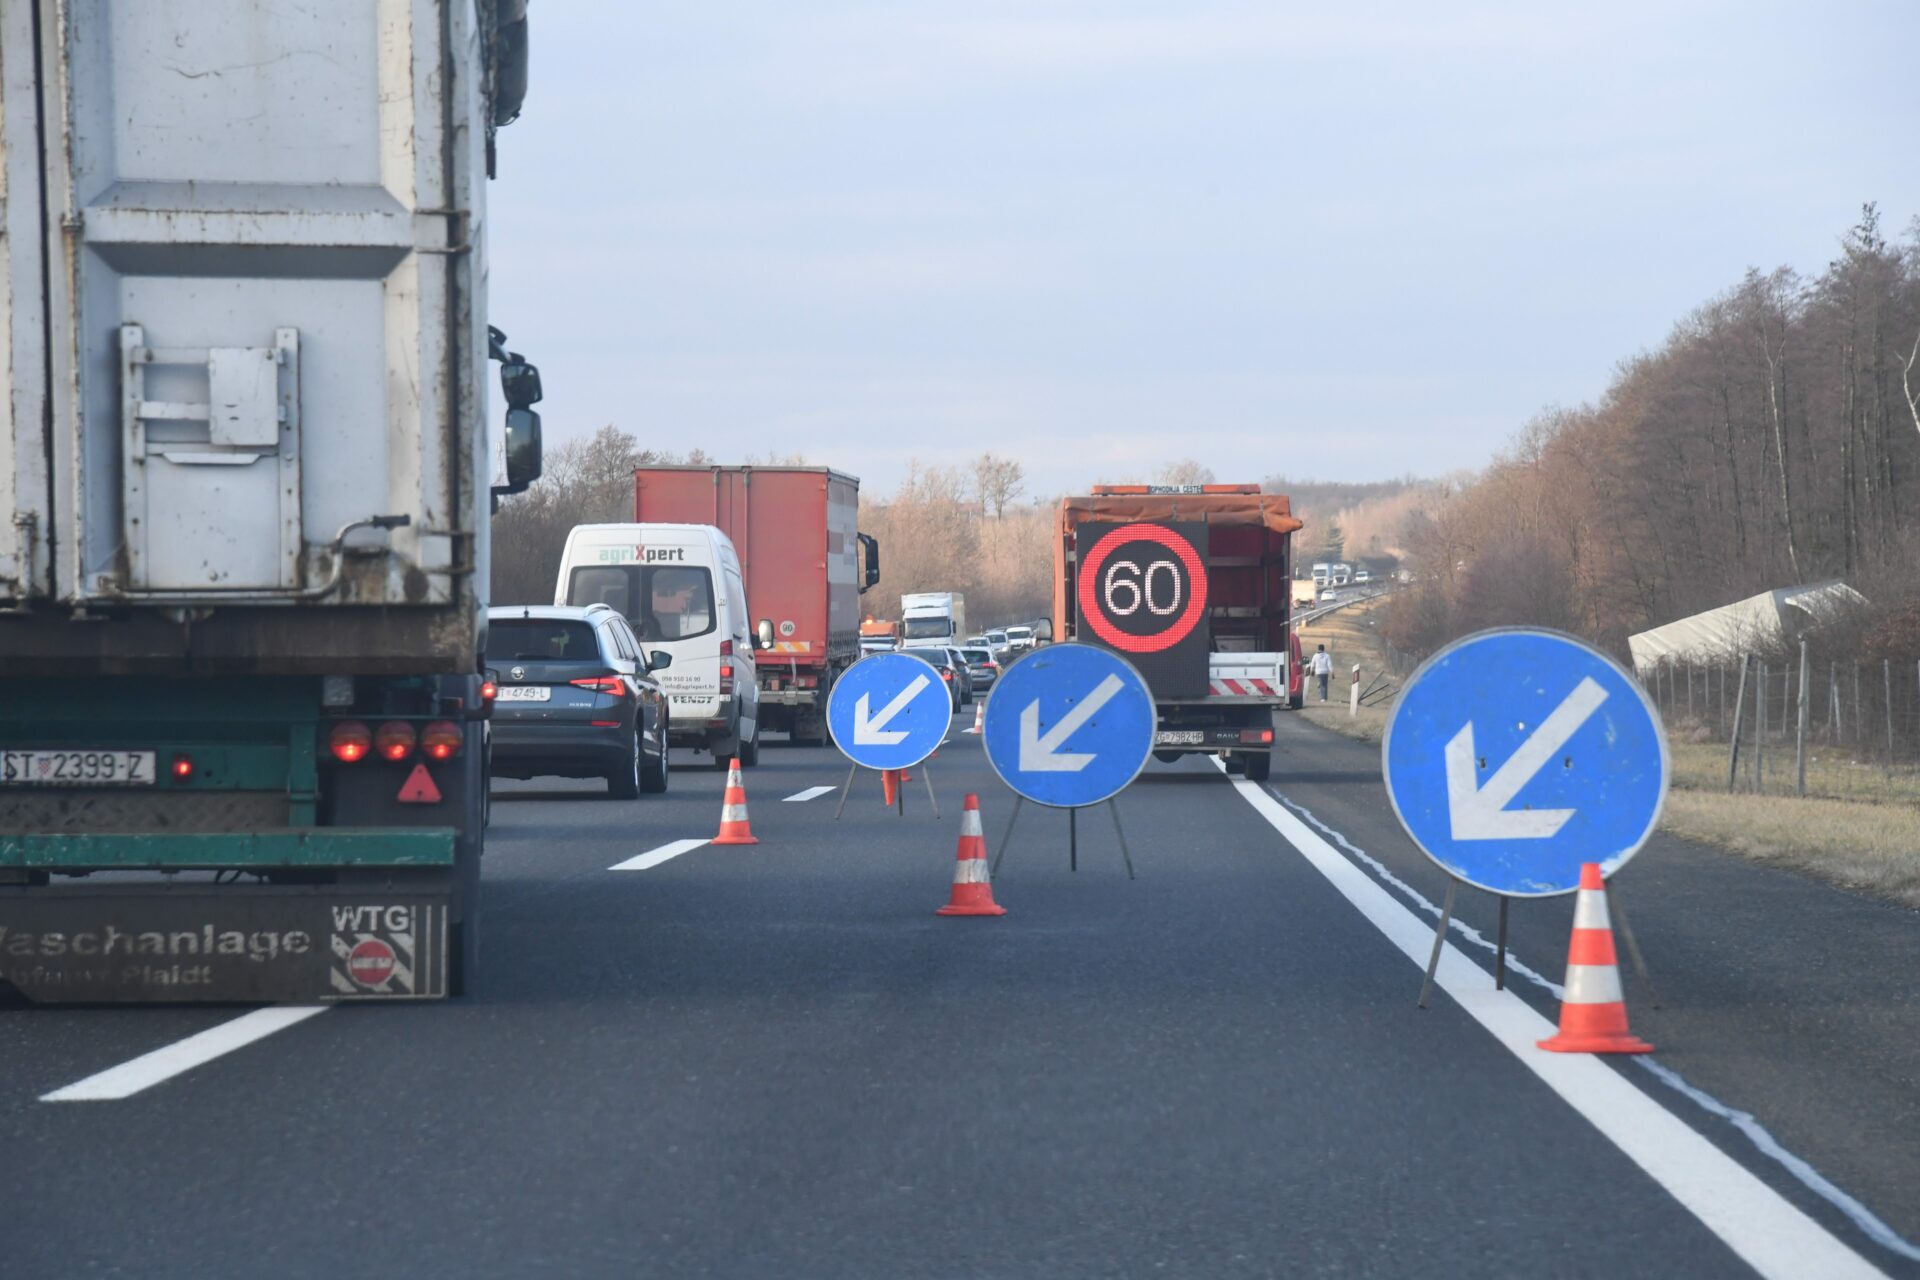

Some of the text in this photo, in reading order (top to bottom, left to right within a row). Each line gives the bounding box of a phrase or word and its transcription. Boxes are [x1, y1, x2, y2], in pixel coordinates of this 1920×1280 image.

[599, 544, 684, 565] agriXpert
[1104, 560, 1181, 615] 60
[782, 623, 793, 633] 90
[672, 695, 715, 704] FENDT
[4, 753, 143, 779] ST 2399-Z
[332, 905, 410, 931] WTG
